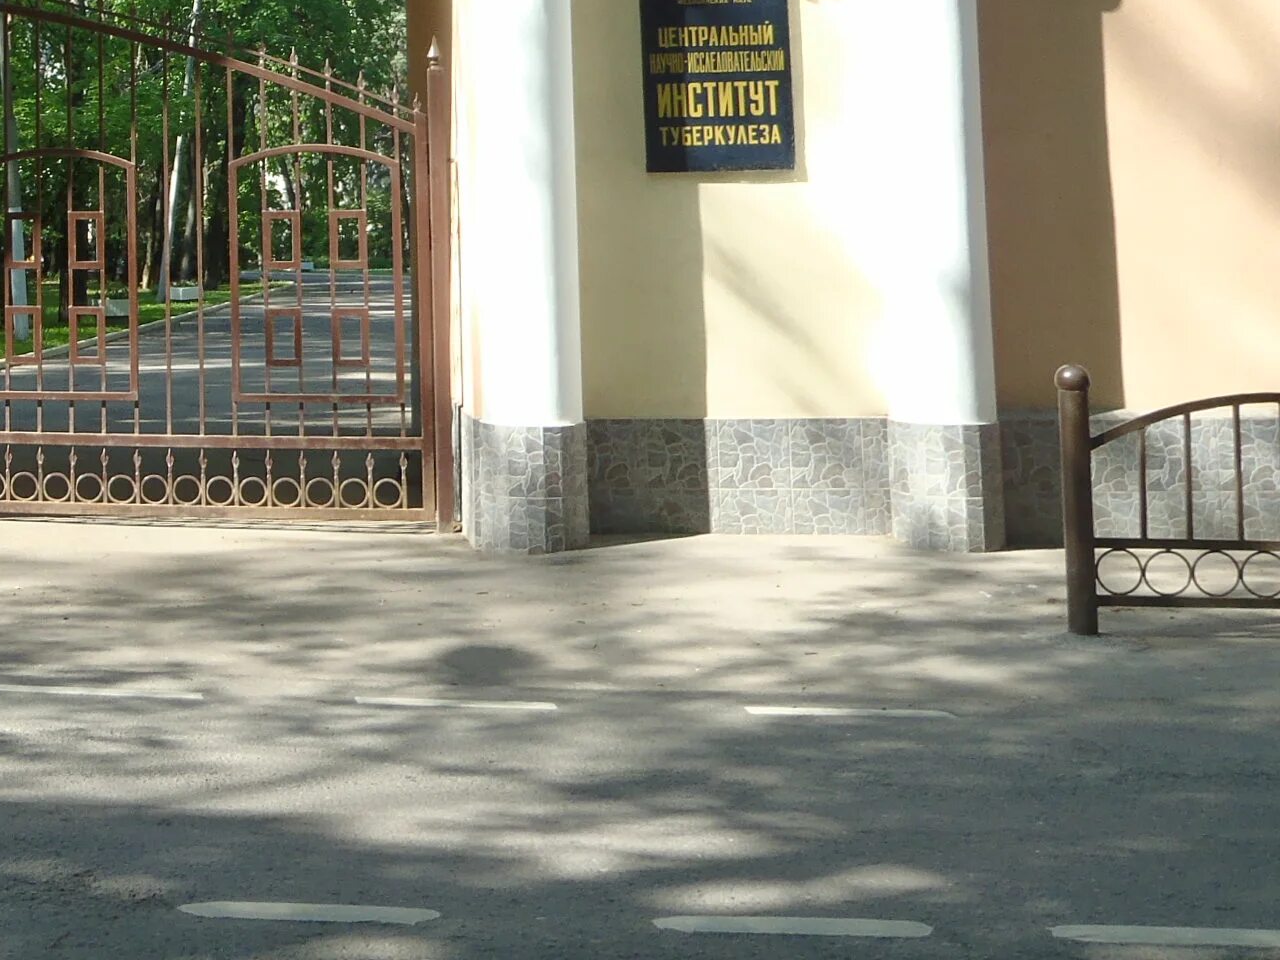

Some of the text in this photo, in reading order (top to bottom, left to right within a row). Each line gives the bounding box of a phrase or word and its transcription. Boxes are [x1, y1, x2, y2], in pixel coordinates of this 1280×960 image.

[658, 21, 774, 48] ЦЕНТРАЛЬНЫЙ
[649, 48, 785, 74] НАУЧНО-ИССЛЕДОВАТЕЛЬСКИЙ
[657, 80, 780, 118] ИНСТИТУТ
[659, 123, 782, 146] ТУБЕРКУЛЕЗА
